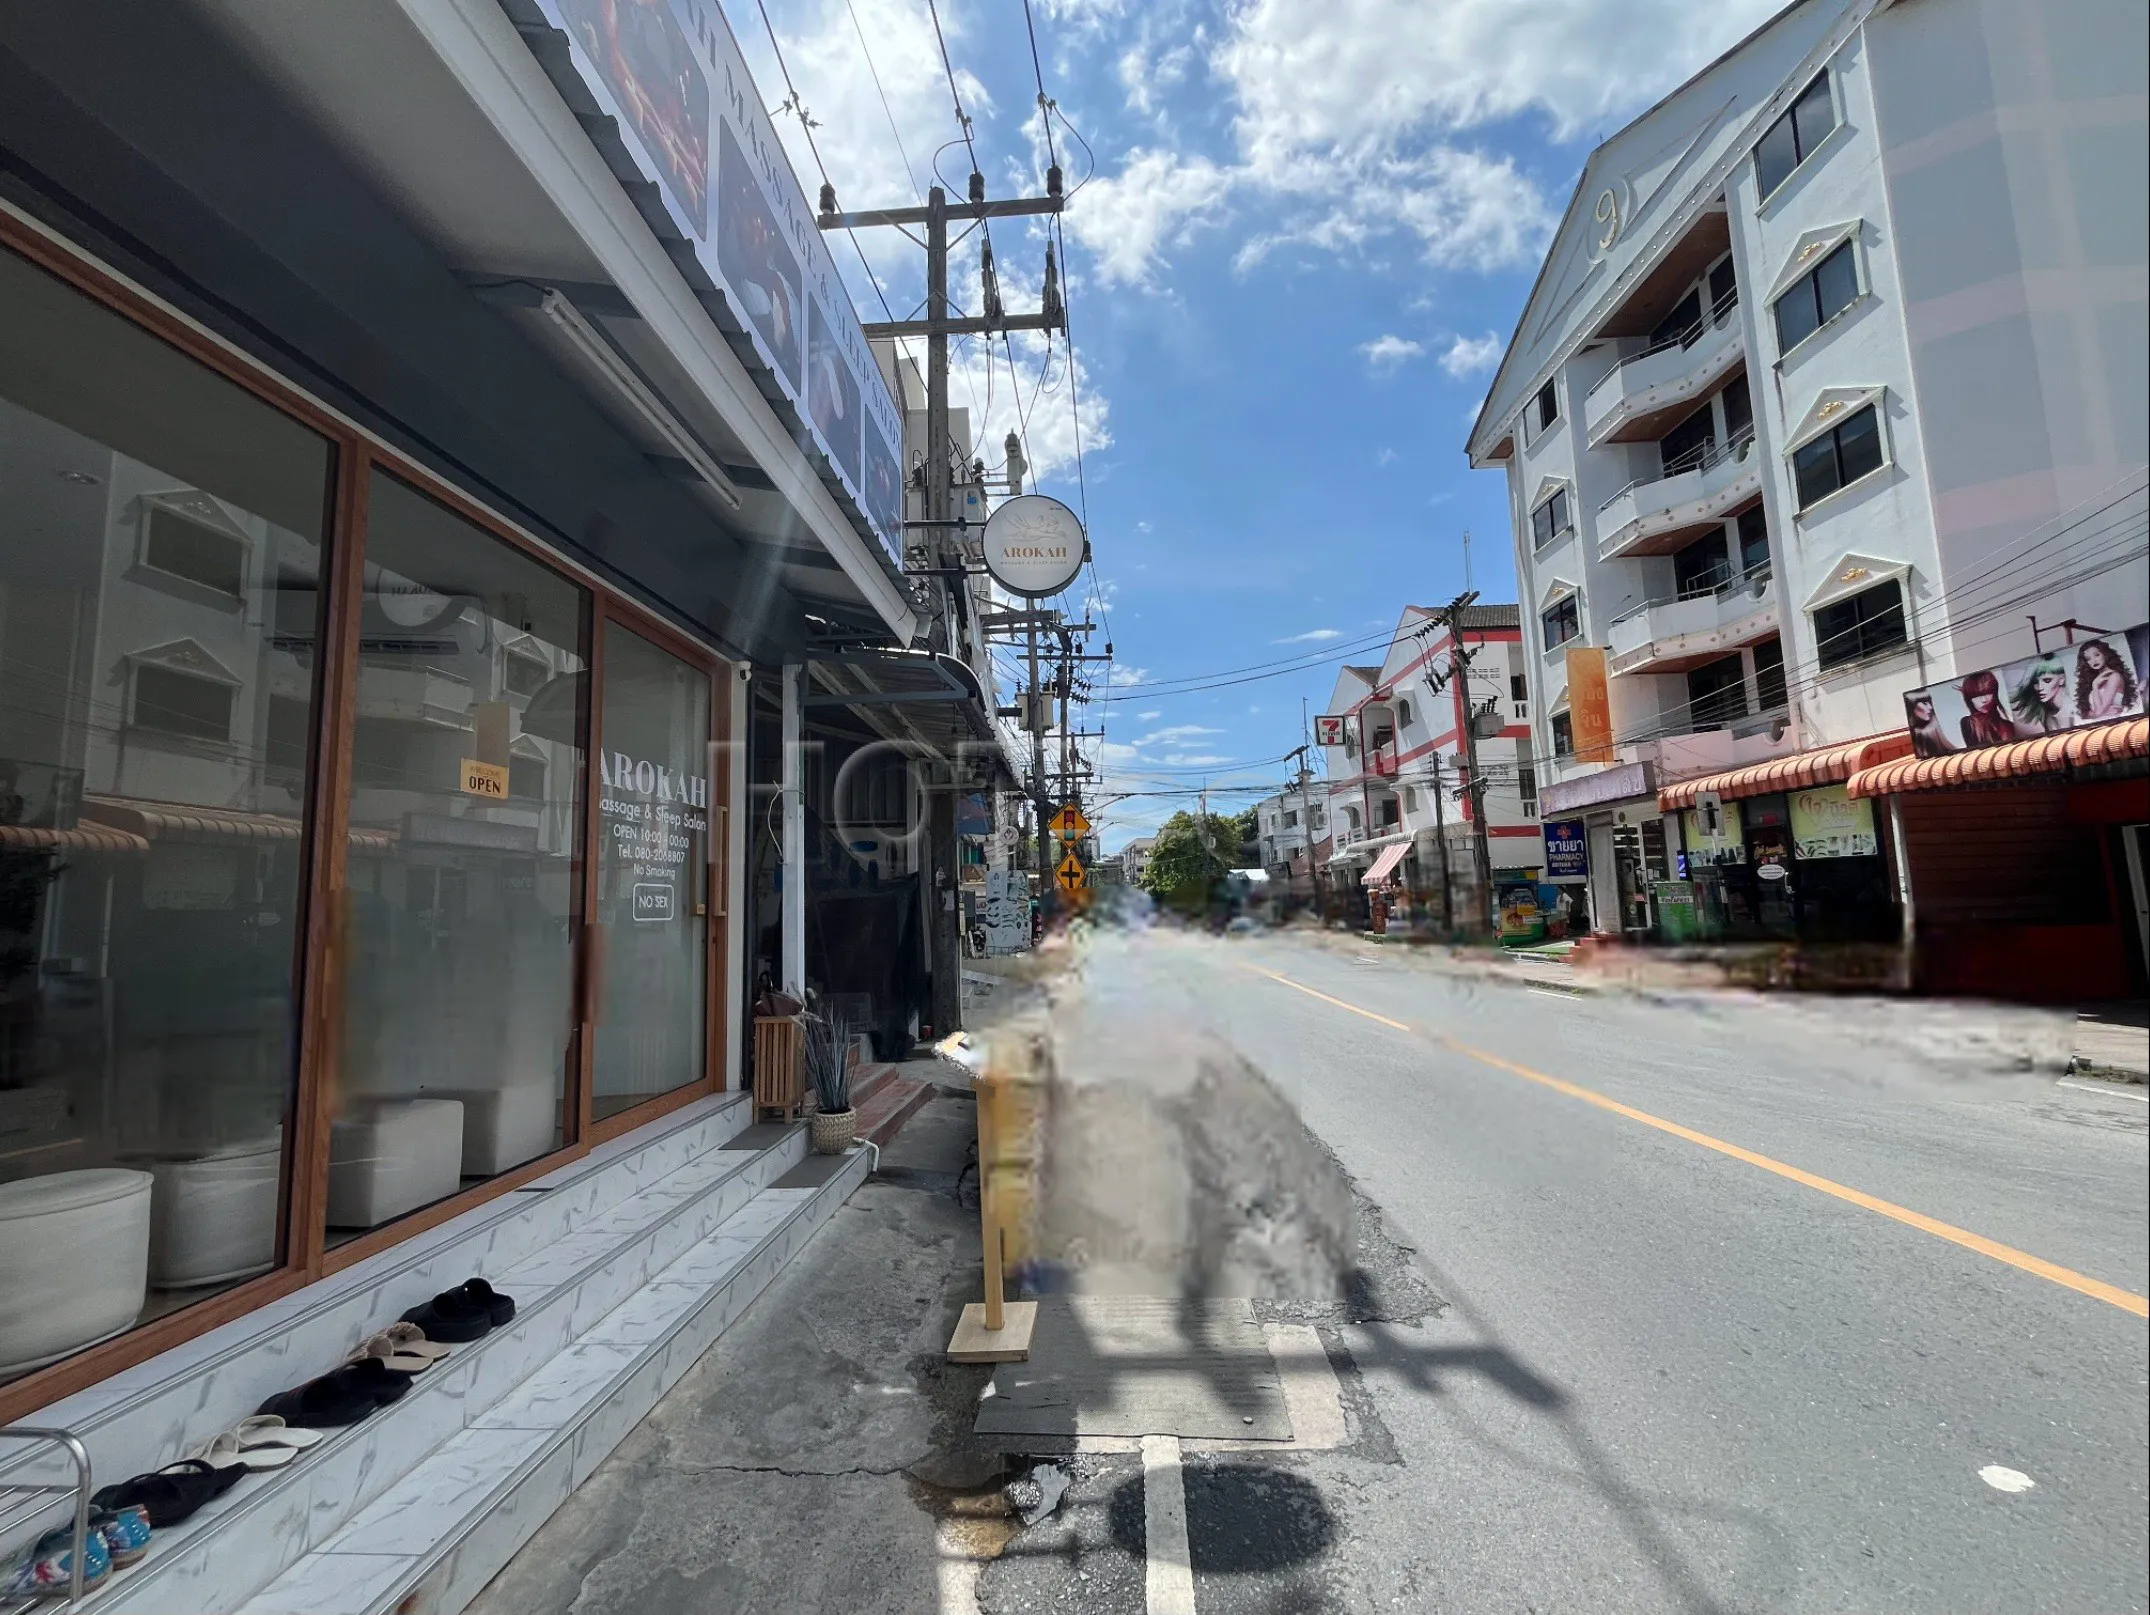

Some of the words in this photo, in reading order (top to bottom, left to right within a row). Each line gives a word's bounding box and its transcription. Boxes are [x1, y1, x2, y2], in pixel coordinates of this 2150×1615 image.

[724, 60, 817, 279] MASSAGE
[1001, 547, 1067, 558] AROKAH
[469, 775, 501, 793] OPEN
[600, 747, 707, 809] AROKAH
[644, 804, 652, 820] &
[656, 806, 681, 831] Sleep
[683, 813, 707, 831] Salon
[613, 823, 637, 840] OPEN
[640, 829, 662, 843] 10:00
[669, 834, 690, 849] 00:00
[617, 843, 633, 858] Tel.
[1547, 839, 1584, 853] ขายยา
[1548, 852, 1584, 861] PHARMACY
[633, 863, 645, 875] No
[645, 865, 676, 880] Smoking
[638, 896, 653, 909] NO
[655, 895, 669, 909] SEX
